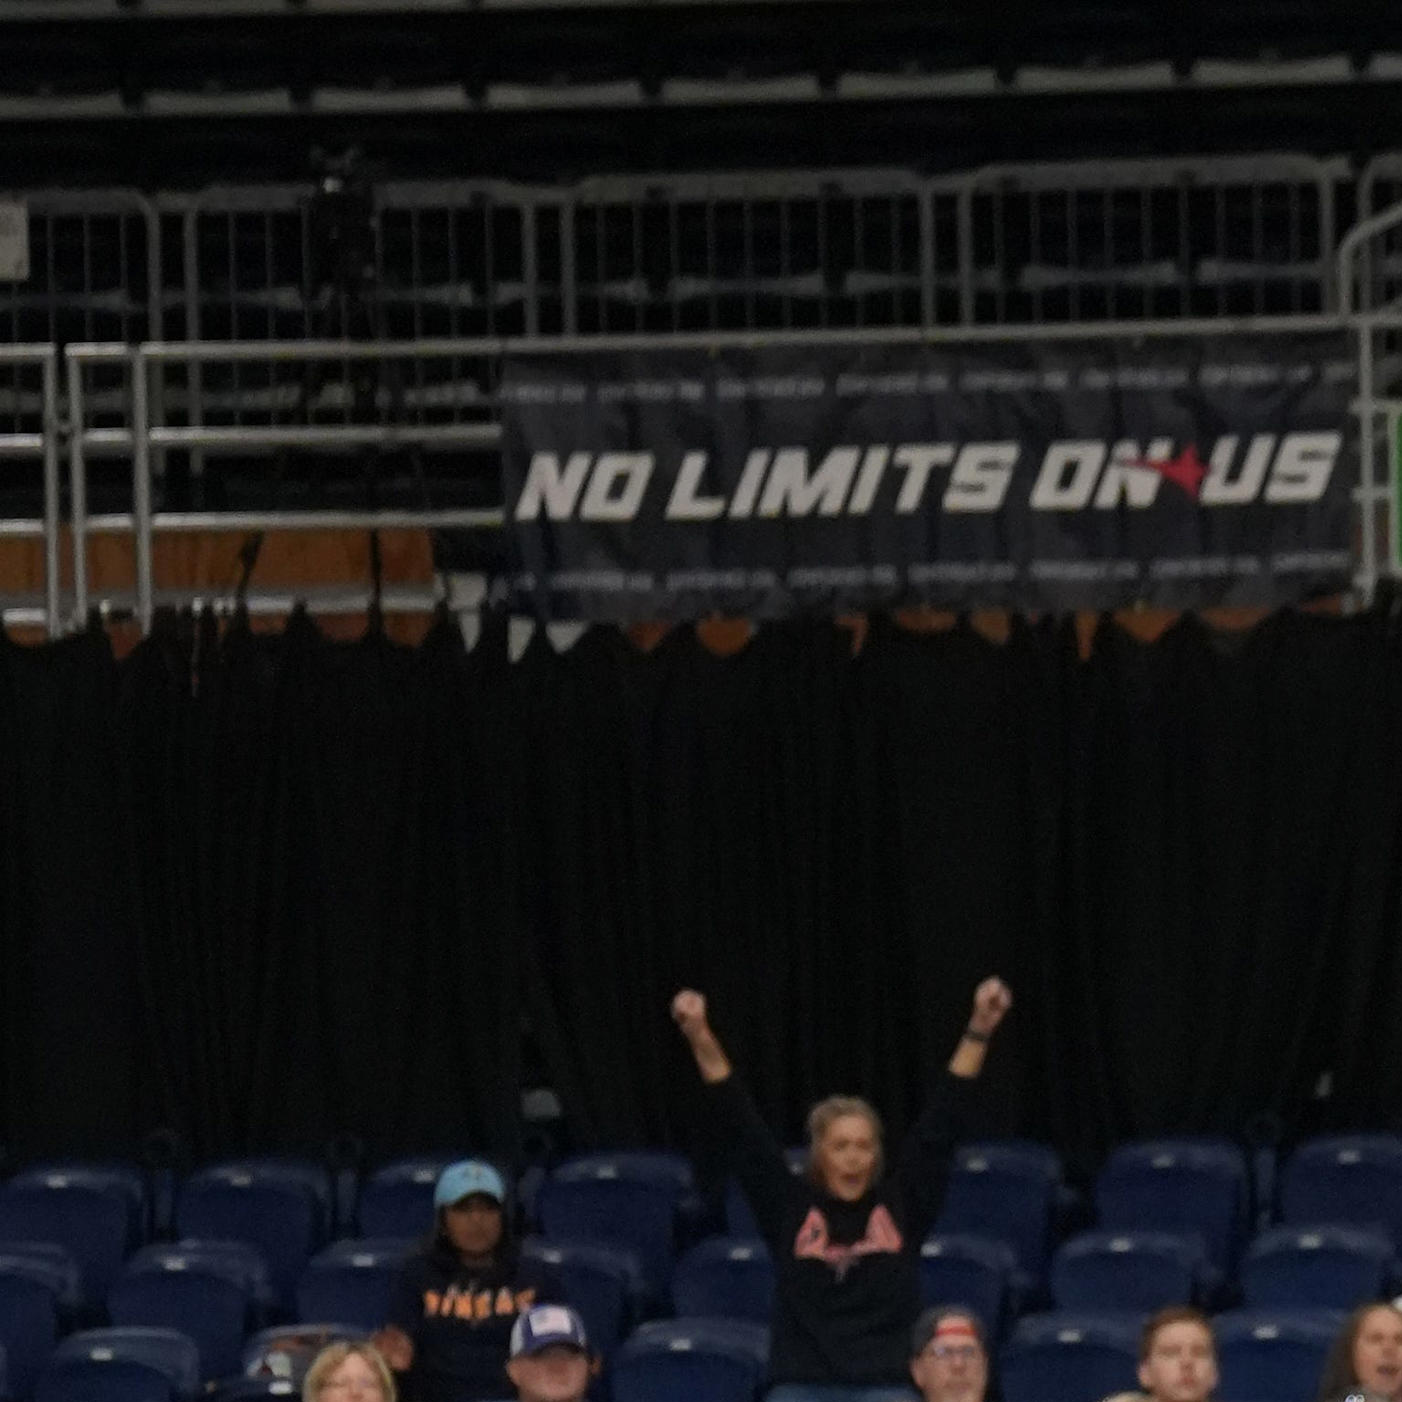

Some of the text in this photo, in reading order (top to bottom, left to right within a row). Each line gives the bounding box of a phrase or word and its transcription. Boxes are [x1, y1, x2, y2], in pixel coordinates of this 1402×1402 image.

[514, 448, 655, 522] NO
[664, 440, 1022, 522] LIMITS
[1200, 429, 1343, 506] US
